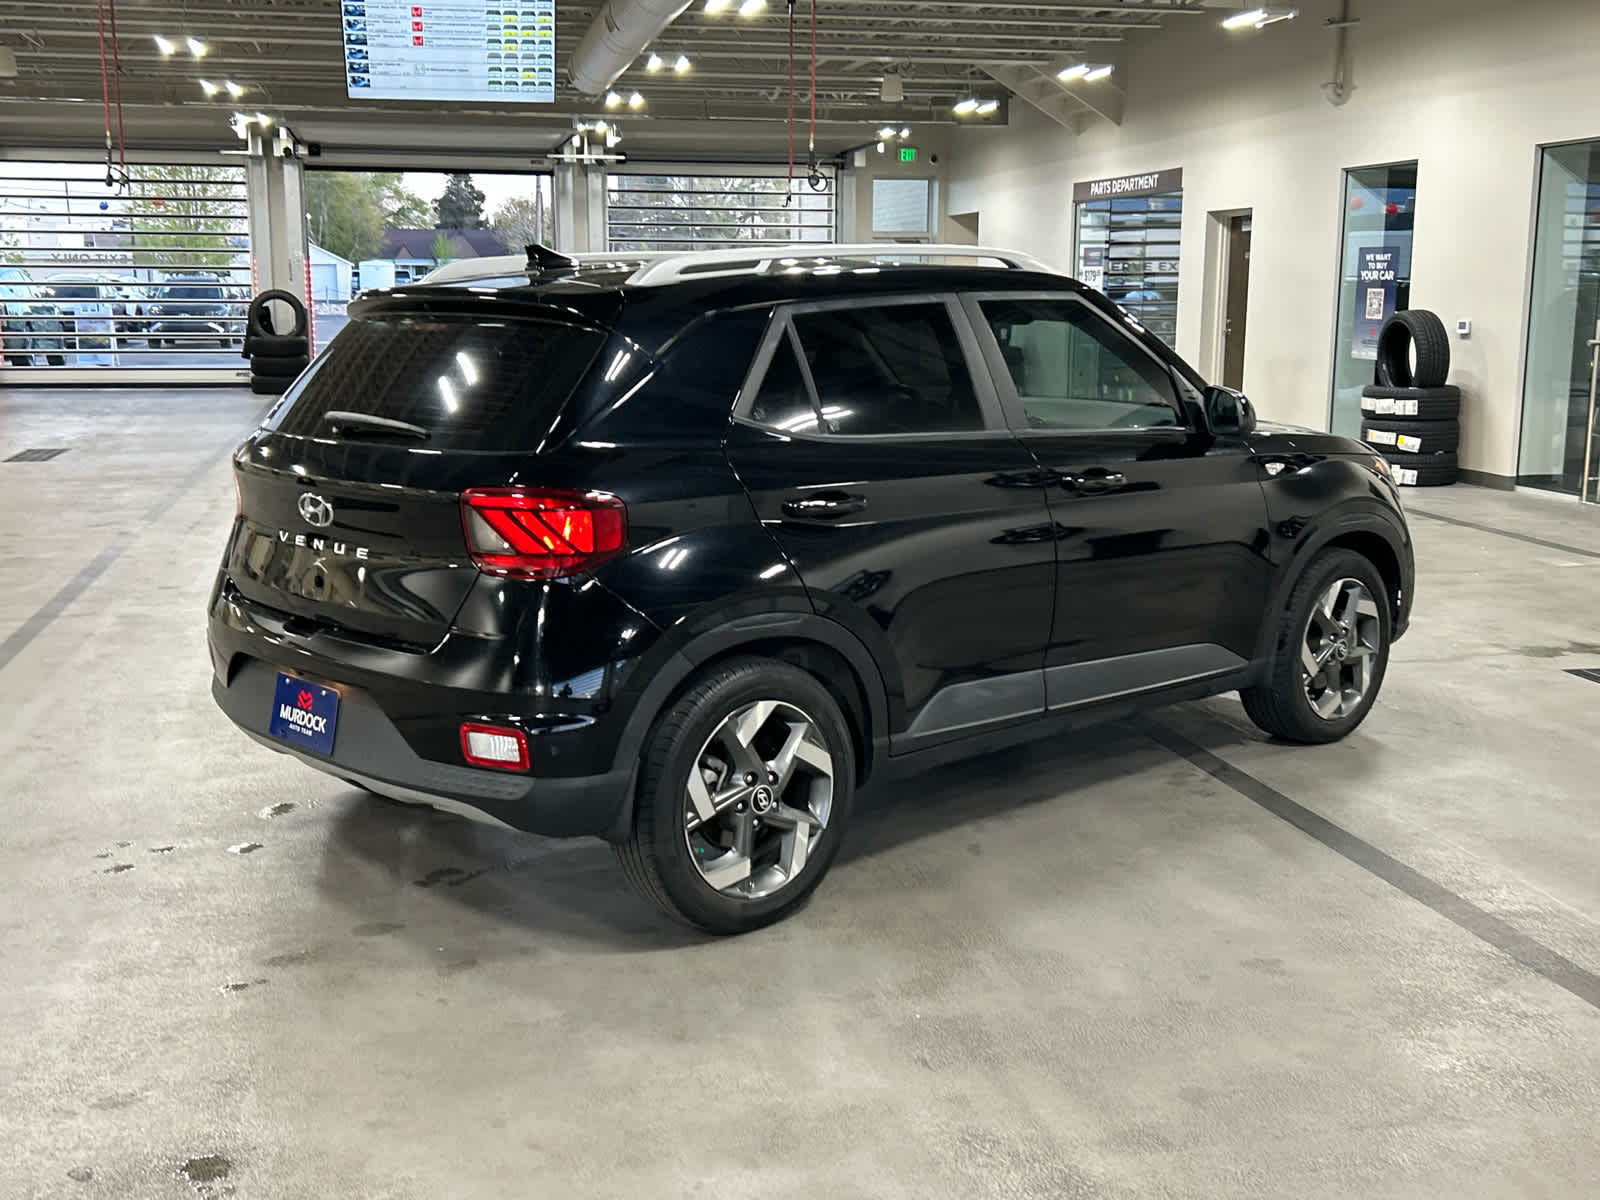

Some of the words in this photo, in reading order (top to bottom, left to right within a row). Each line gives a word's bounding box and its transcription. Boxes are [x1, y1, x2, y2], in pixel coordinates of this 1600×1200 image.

[1090, 180, 1111, 196] PARTS
[1112, 174, 1159, 193] DEPARTMENT
[1360, 270, 1379, 280] YOUR
[1379, 270, 1394, 280] CAR
[1368, 262, 1375, 270] TO
[1376, 262, 1388, 270] BUY
[279, 530, 369, 560] VENUE
[280, 703, 327, 734] MURDOCK
[288, 723, 301, 733] AUTO
[301, 727, 313, 737] TEAM
